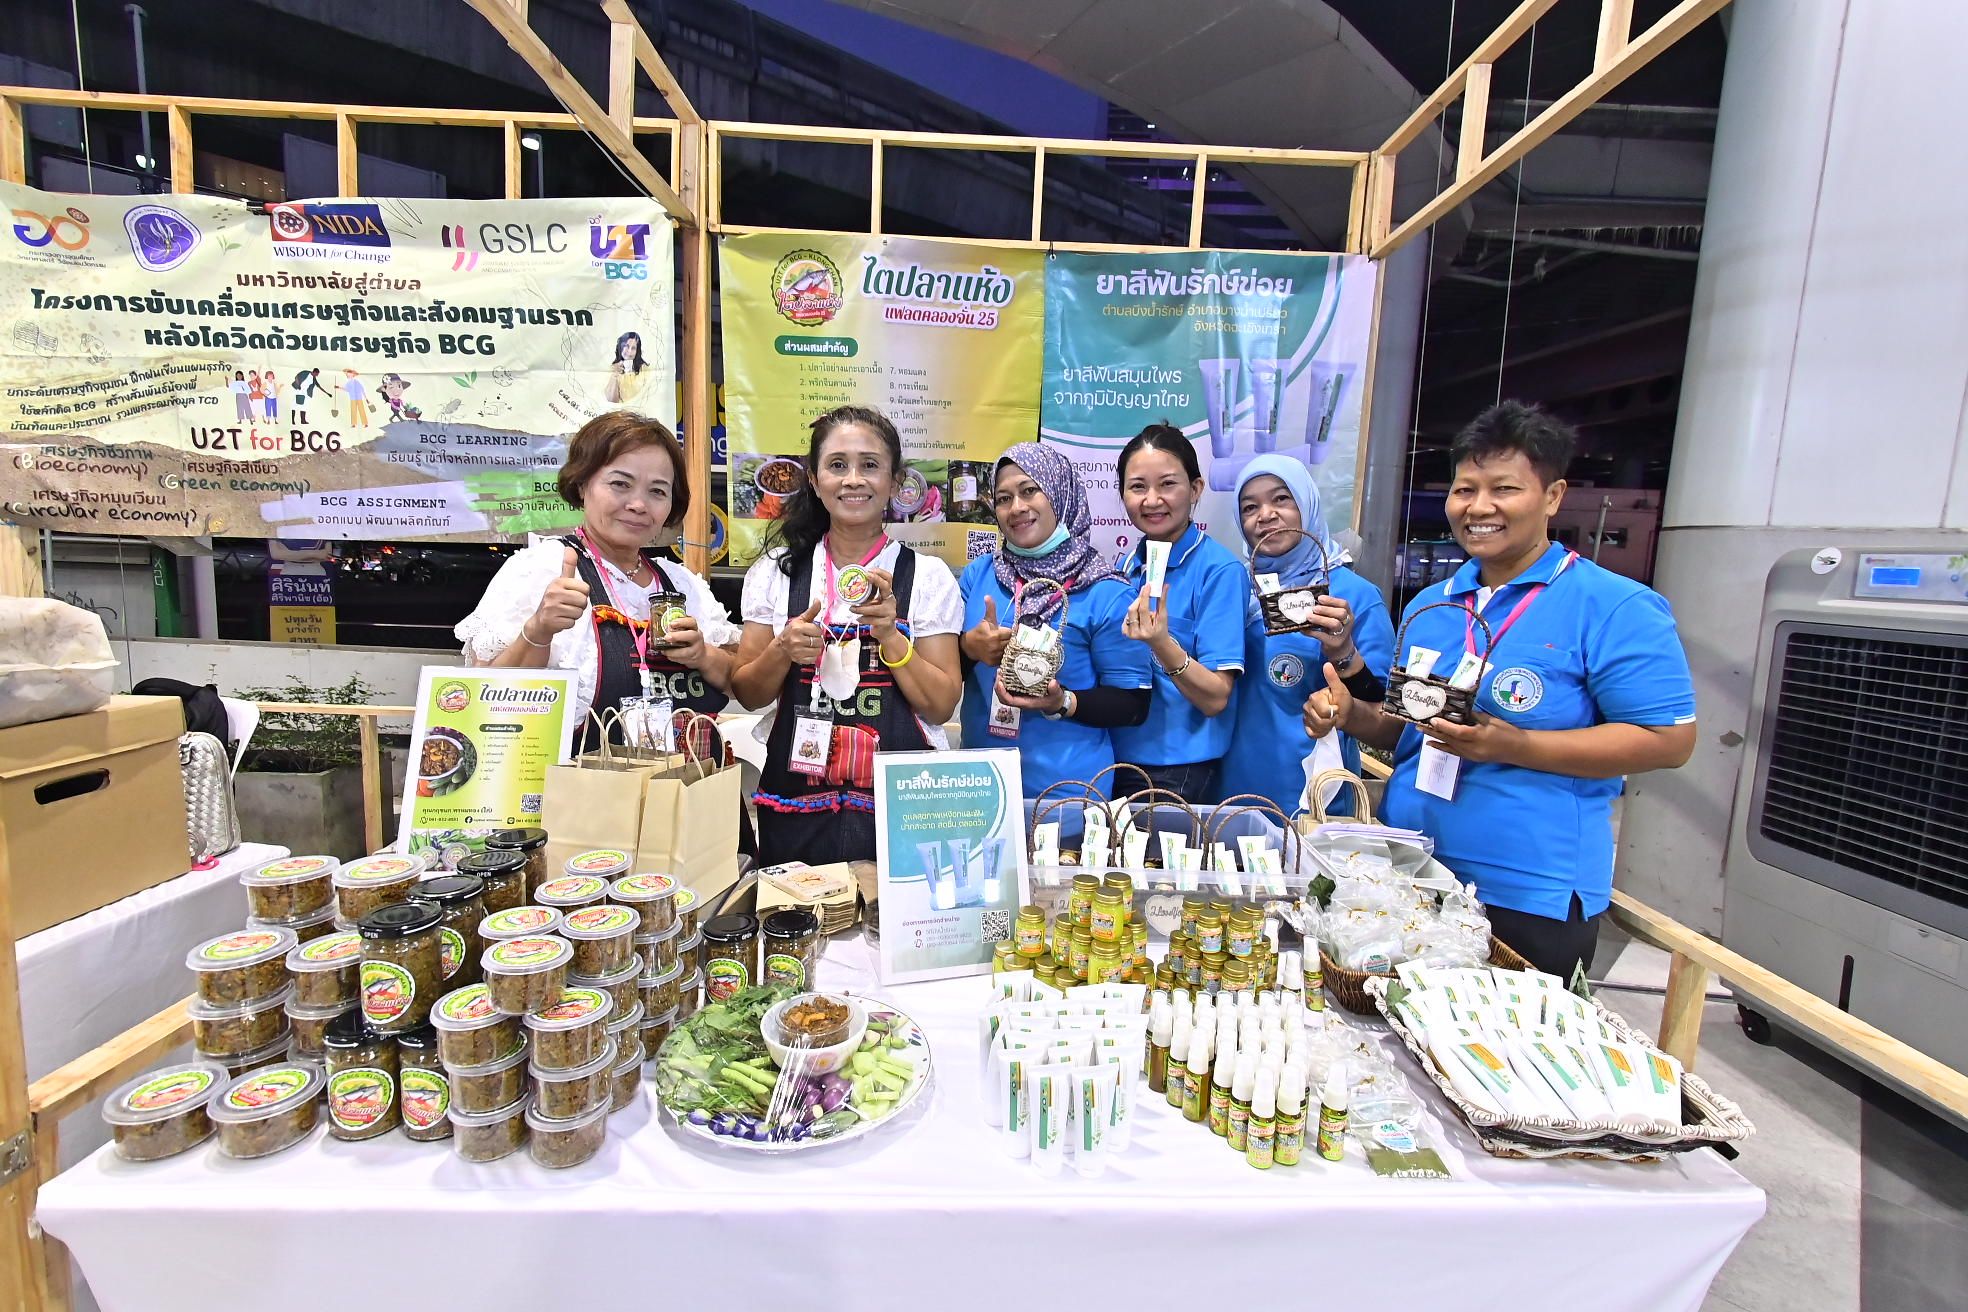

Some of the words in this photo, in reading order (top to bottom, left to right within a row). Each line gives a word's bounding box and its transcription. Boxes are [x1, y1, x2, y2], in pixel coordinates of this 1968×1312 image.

[312, 214, 384, 236] NIDA
[479, 223, 567, 254] GSLC
[589, 224, 651, 261] U2T
[273, 246, 327, 258] WISDOM
[329, 248, 343, 260] for
[344, 250, 391, 264] Change
[604, 262, 648, 281] BCG
[863, 255, 1012, 304] ไตปลาแห้ง
[236, 271, 422, 297] มหาวิทยาลัยสู่ตำบล
[1096, 267, 1294, 298] ยาสีฟันรักษ์ข่อย
[30, 287, 594, 329] โครงการขับเคลื่อนเศรษฐกิจและสังคมฐานราก
[977, 312, 996, 327] 25
[144, 322, 431, 358] หลังโควิดด้วยเศรษฐกิจ
[438, 333, 496, 355] BCG
[784, 340, 849, 356] ส่วนผสมสำคัญ
[1063, 365, 1182, 388] ยาสีฟันสมุนไพร
[74, 400, 96, 412] BCG
[1053, 389, 1190, 411] จากภูมิปัญญาไทย
[190, 427, 243, 450] U2T
[250, 429, 283, 450] for
[290, 429, 342, 452] BCG
[420, 433, 447, 445] BCG
[456, 434, 528, 447] LEARNING
[13, 452, 149, 482] (Bioeconomy)
[182, 459, 279, 476] เศรษฐกิจสีเขียว
[387, 450, 422, 467] เรียนรู้
[424, 449, 559, 466] เข้าใจหลักการและแนวคิด
[158, 473, 221, 491] (Green
[229, 477, 311, 499] economy)
[33, 488, 167, 509] เศรษฐกิจหมุนเวียน
[320, 496, 348, 508] BCG
[356, 497, 447, 509] ASSIGNMENT
[499, 498, 565, 512] กระจายสินค้า
[3, 501, 99, 521] (Circular
[108, 507, 197, 528] economy)
[317, 515, 363, 526] ออกแบบ
[365, 513, 451, 528] พัฒนาผลิตภัณฑ์
[271, 577, 331, 593] ศิรินันท์
[284, 614, 322, 625] ปทุมวัน
[286, 625, 321, 634] บางรัก
[480, 683, 558, 702] ไตปลาแห้ง
[649, 670, 705, 700] BCG
[990, 726, 1016, 737] EXHIBITOR
[792, 762, 823, 773] EXHIBITOR
[364, 931, 379, 939] OPEN
